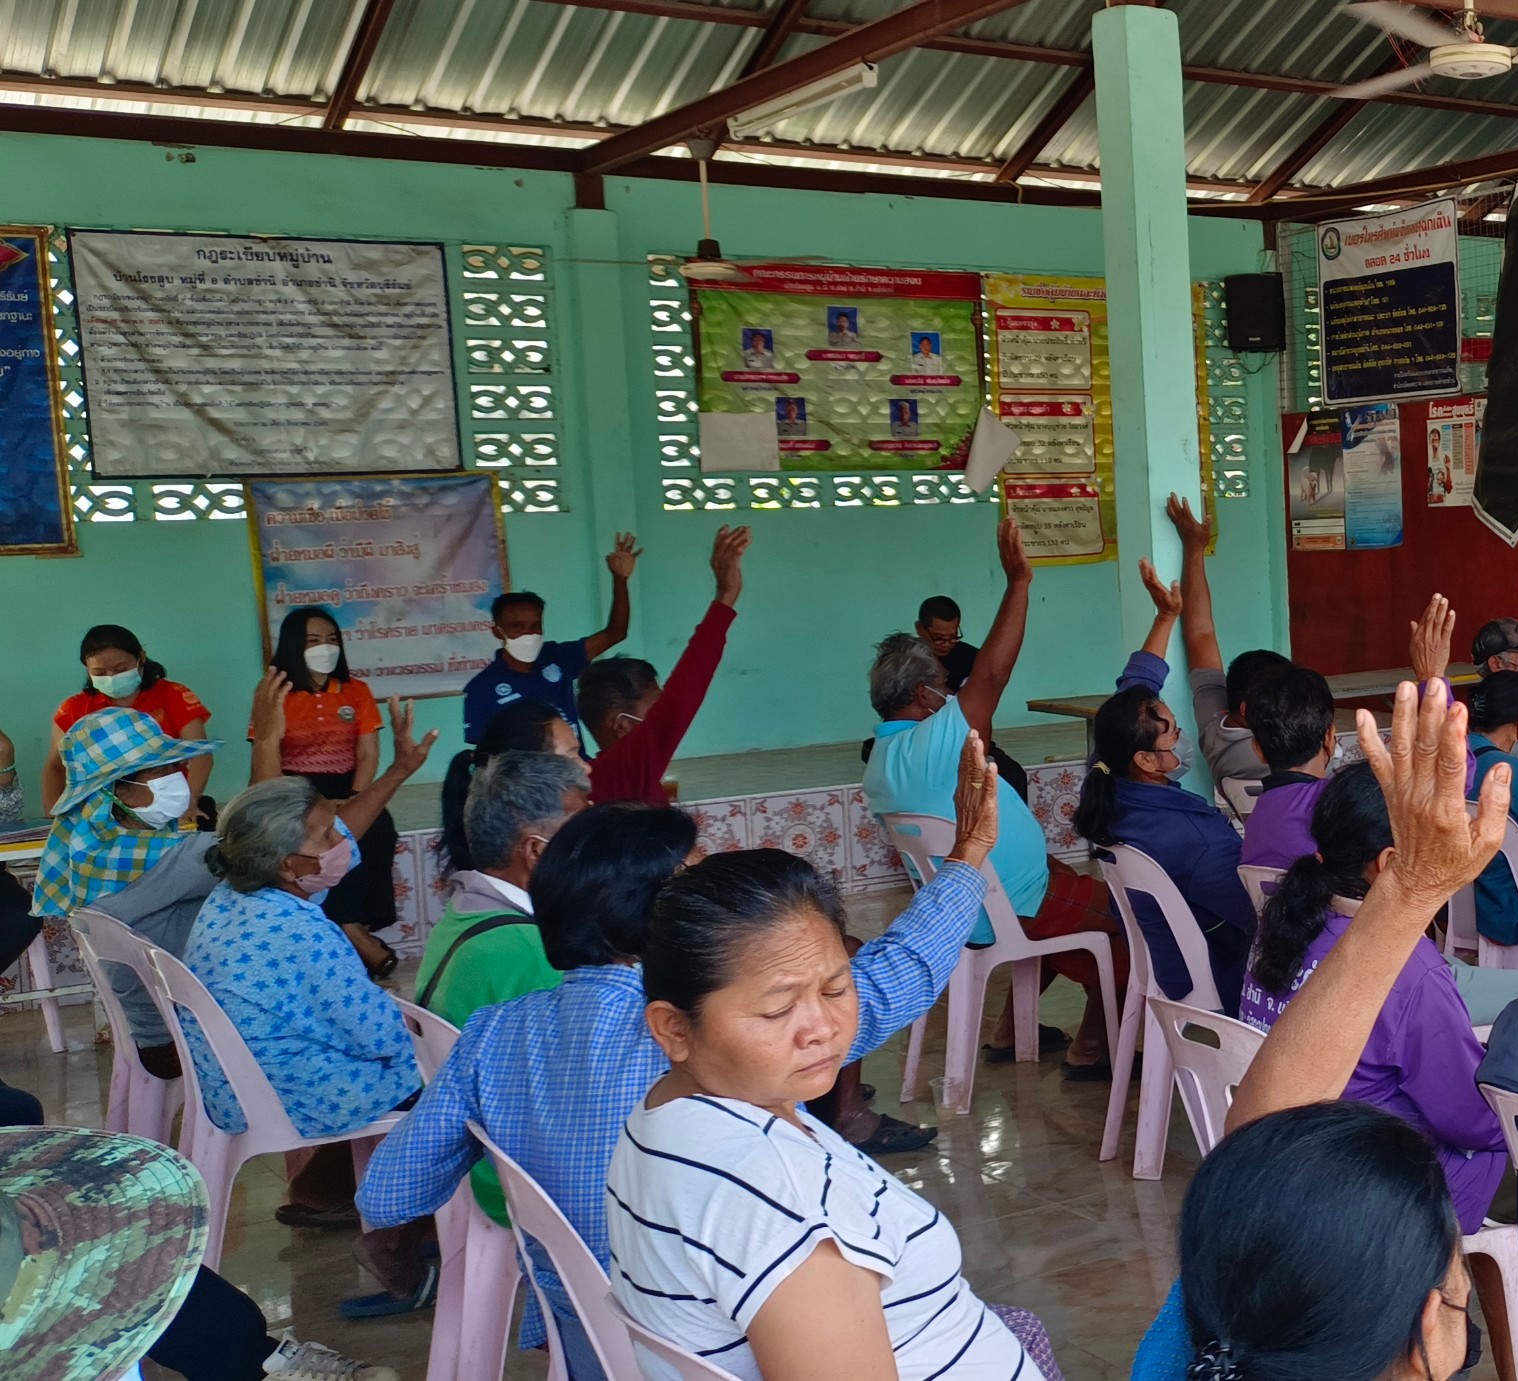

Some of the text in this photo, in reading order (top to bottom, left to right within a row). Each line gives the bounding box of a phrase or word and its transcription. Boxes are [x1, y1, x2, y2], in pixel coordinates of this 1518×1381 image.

[196, 246, 333, 268] กฎระเบียบหมู่บ้าน
[1389, 254, 1401, 264] 24
[1403, 243, 1430, 261] ชั่วโมง
[180, 270, 205, 289] หมู่ที่
[211, 277, 218, 285] 8
[1267, 997, 1275, 1012] จ.
